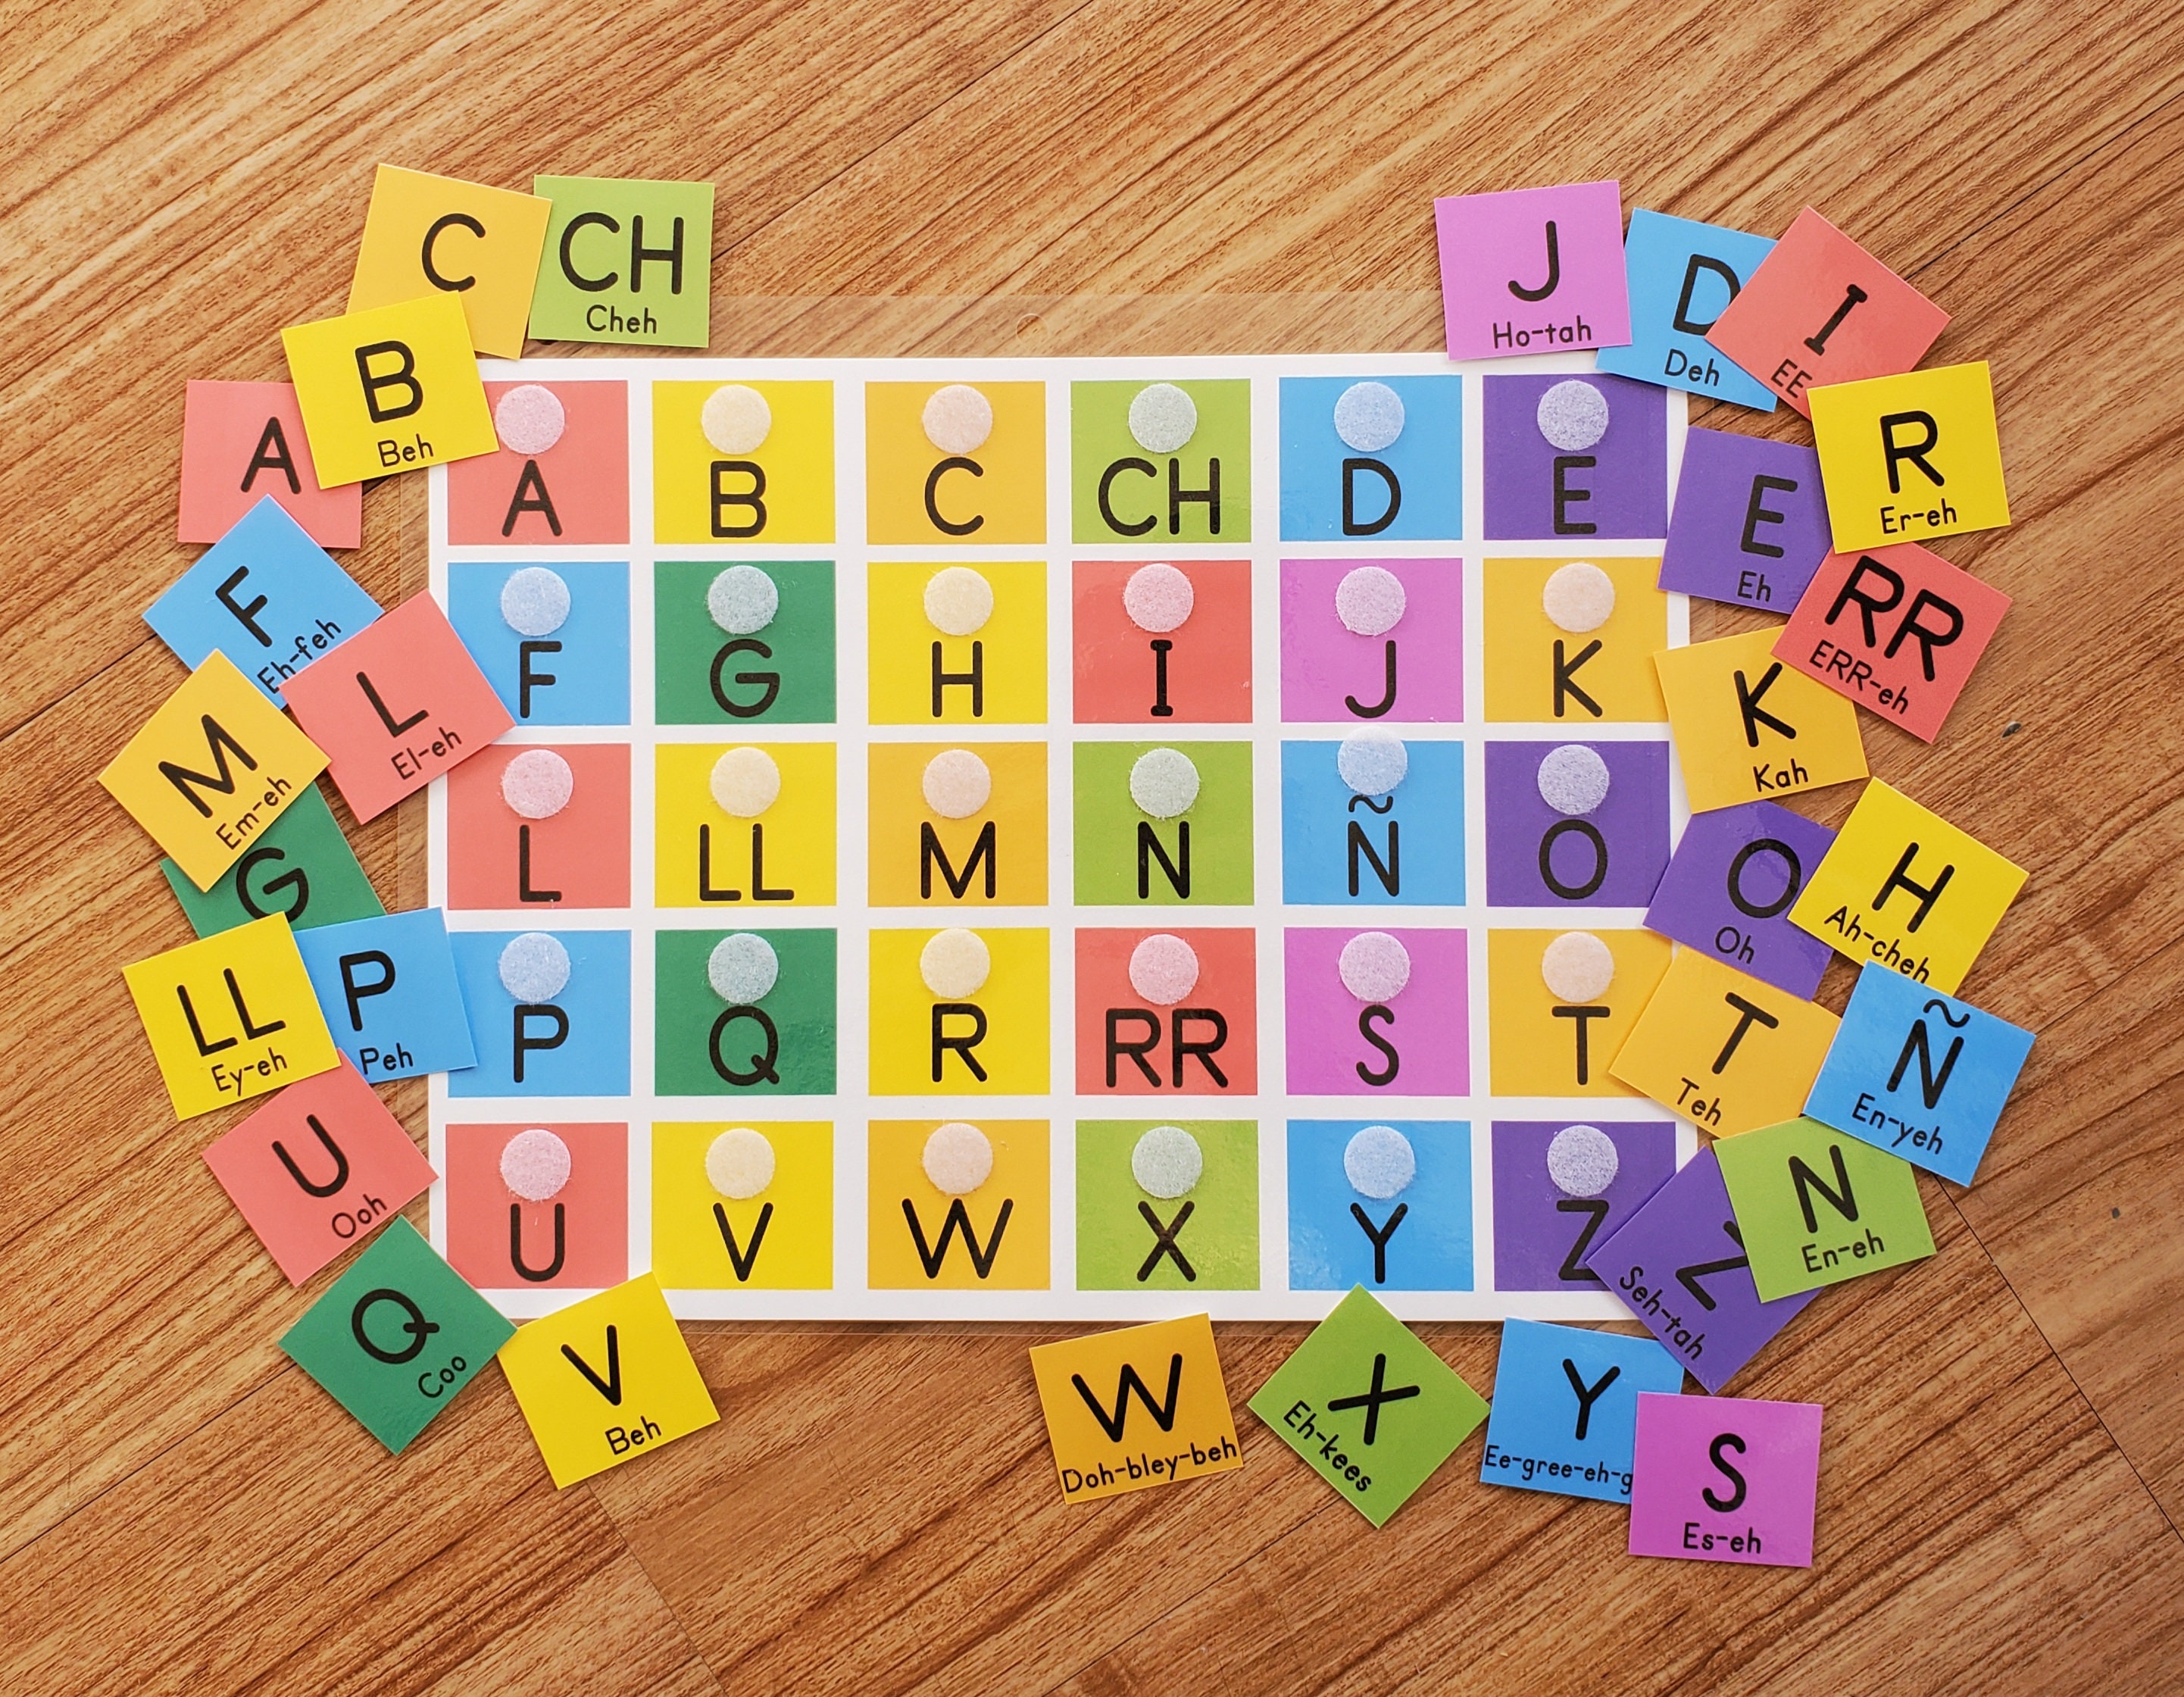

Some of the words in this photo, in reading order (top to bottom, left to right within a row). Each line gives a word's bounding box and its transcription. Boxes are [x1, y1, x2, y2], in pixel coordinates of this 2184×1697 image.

[422, 214, 485, 292] C
[560, 212, 683, 294] CH
[1508, 221, 1559, 301] J
[587, 305, 656, 333] Cheh
[1494, 315, 1592, 348] Ho-tah
[1673, 255, 1741, 336] D
[1804, 284, 1867, 355] I
[355, 341, 423, 423] B
[1664, 348, 1720, 386] Deh
[1770, 358, 1813, 398] EE
[242, 417, 300, 493] A
[378, 435, 433, 467] Beh
[1880, 411, 1944, 493] R
[503, 461, 561, 536] A
[711, 461, 766, 537] B
[925, 458, 983, 535] C
[1098, 458, 1220, 536] CH
[1343, 458, 1401, 536] D
[1554, 456, 1597, 534] E
[1740, 475, 1799, 558] E
[1880, 498, 1957, 534] Er-eh
[216, 567, 272, 647] F
[1737, 570, 1771, 602] Eh
[1826, 555, 1964, 682] RR
[258, 619, 342, 694] Eh-feh
[520, 641, 562, 718] F
[709, 638, 780, 718] G
[933, 641, 983, 717] H
[1151, 640, 1173, 716] I
[1345, 641, 1396, 718] J
[1554, 640, 1602, 717] K
[1810, 639, 1908, 714] ERR-eh
[357, 673, 427, 737] L
[1735, 663, 1796, 747] K
[158, 714, 257, 818] M
[389, 725, 462, 782] El-eh
[1754, 758, 1808, 792] Kah
[214, 774, 292, 851] Em-eh
[1348, 795, 1399, 896] Ñ
[236, 847, 309, 924] G
[520, 826, 561, 902] L
[700, 824, 793, 901] LL
[921, 822, 995, 899] M
[1138, 821, 1189, 899] N
[1539, 819, 1608, 900] O
[1727, 838, 1801, 919] O
[1873, 842, 1954, 933] H
[1714, 926, 1755, 965] Oh
[1823, 905, 1930, 984] Ah-cheh
[177, 968, 286, 1057] LL
[339, 951, 395, 1031] P
[211, 1048, 288, 1096] Ey-eh
[358, 1041, 415, 1076] Peh
[514, 1004, 569, 1083] P
[708, 1005, 780, 1086] Q
[933, 1004, 987, 1082] R
[1106, 1009, 1228, 1087] RR
[1357, 1005, 1398, 1086] S
[1552, 1006, 1610, 1085] T
[1713, 993, 1778, 1074] T
[1886, 999, 1970, 1109] Ñ
[1678, 1078, 1720, 1125] Teh
[1852, 1093, 1942, 1155] En-yeh
[273, 1115, 348, 1197] U
[1789, 1145, 1858, 1233] N
[332, 1195, 387, 1239] Ooh
[511, 1204, 564, 1281] U
[714, 1203, 773, 1281] V
[902, 1199, 1013, 1278] W
[1137, 1202, 1196, 1282] X
[1351, 1203, 1408, 1283] Y
[1556, 1199, 1610, 1281] Z
[1801, 1229, 1886, 1273] En-eh
[351, 1288, 440, 1365] Q
[1619, 1265, 1706, 1361] Seh-tah
[417, 1355, 467, 1399] Coo
[561, 1326, 621, 1405] V
[1072, 1354, 1182, 1442] W
[1327, 1353, 1420, 1445] X
[1563, 1359, 1620, 1440] Y
[605, 1417, 661, 1455] Beh
[1062, 1435, 1238, 1495] Doh-bley-beh
[1282, 1399, 1373, 1493] Eh-kees
[1702, 1433, 1746, 1512] S
[1684, 1523, 1761, 1554] Es-eh
